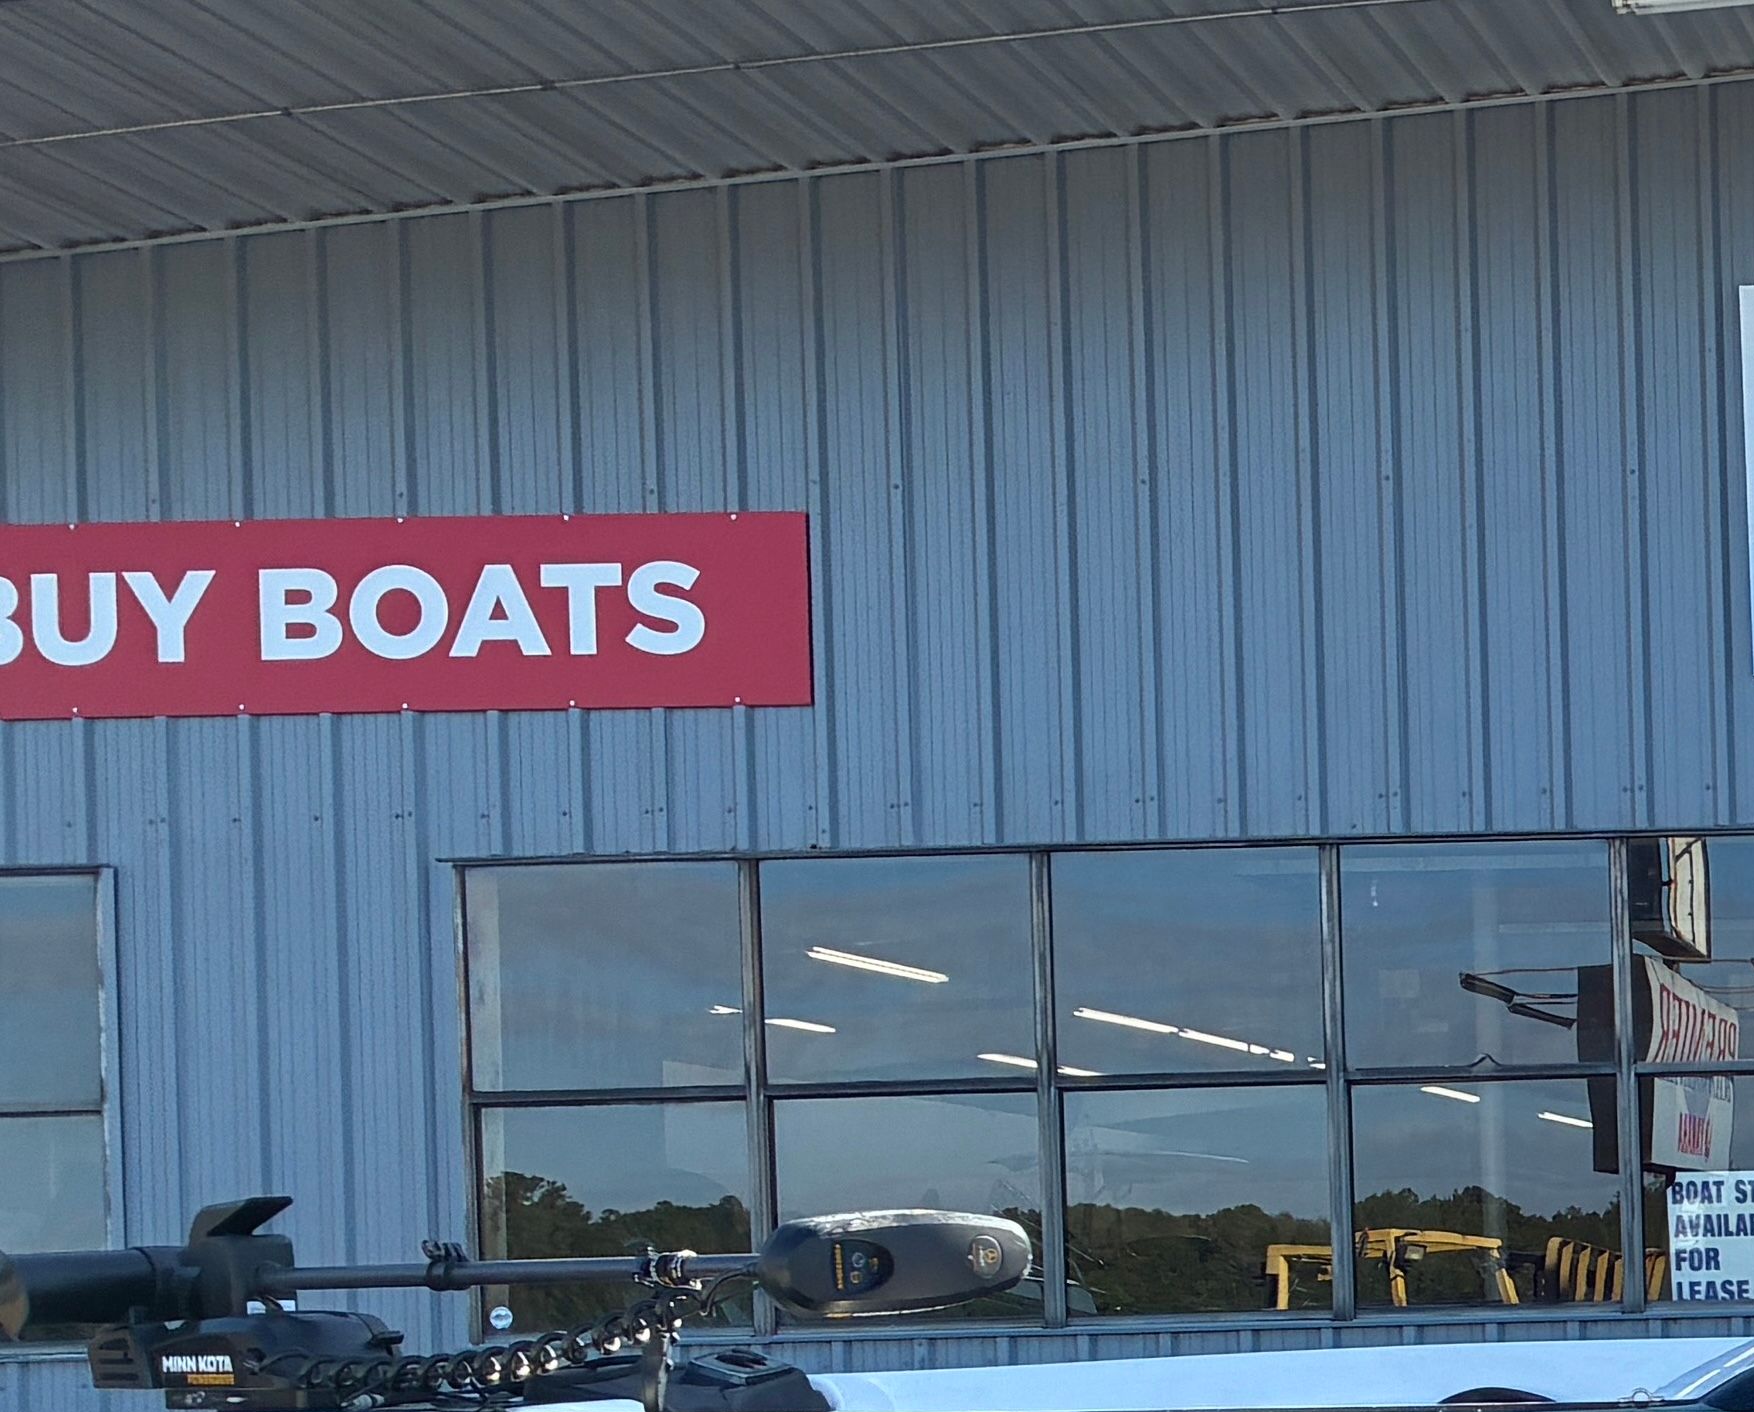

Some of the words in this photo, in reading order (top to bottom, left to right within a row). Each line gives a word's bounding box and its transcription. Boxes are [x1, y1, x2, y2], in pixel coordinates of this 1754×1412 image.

[0, 569, 216, 667] UY
[257, 560, 706, 662] BOATS
[1671, 1179, 1725, 1204] BOAT
[1675, 1247, 1721, 1271] FOR
[1676, 1280, 1750, 1300] LEASE
[162, 1355, 197, 1373] MINN
[197, 1355, 233, 1373] KOTA
